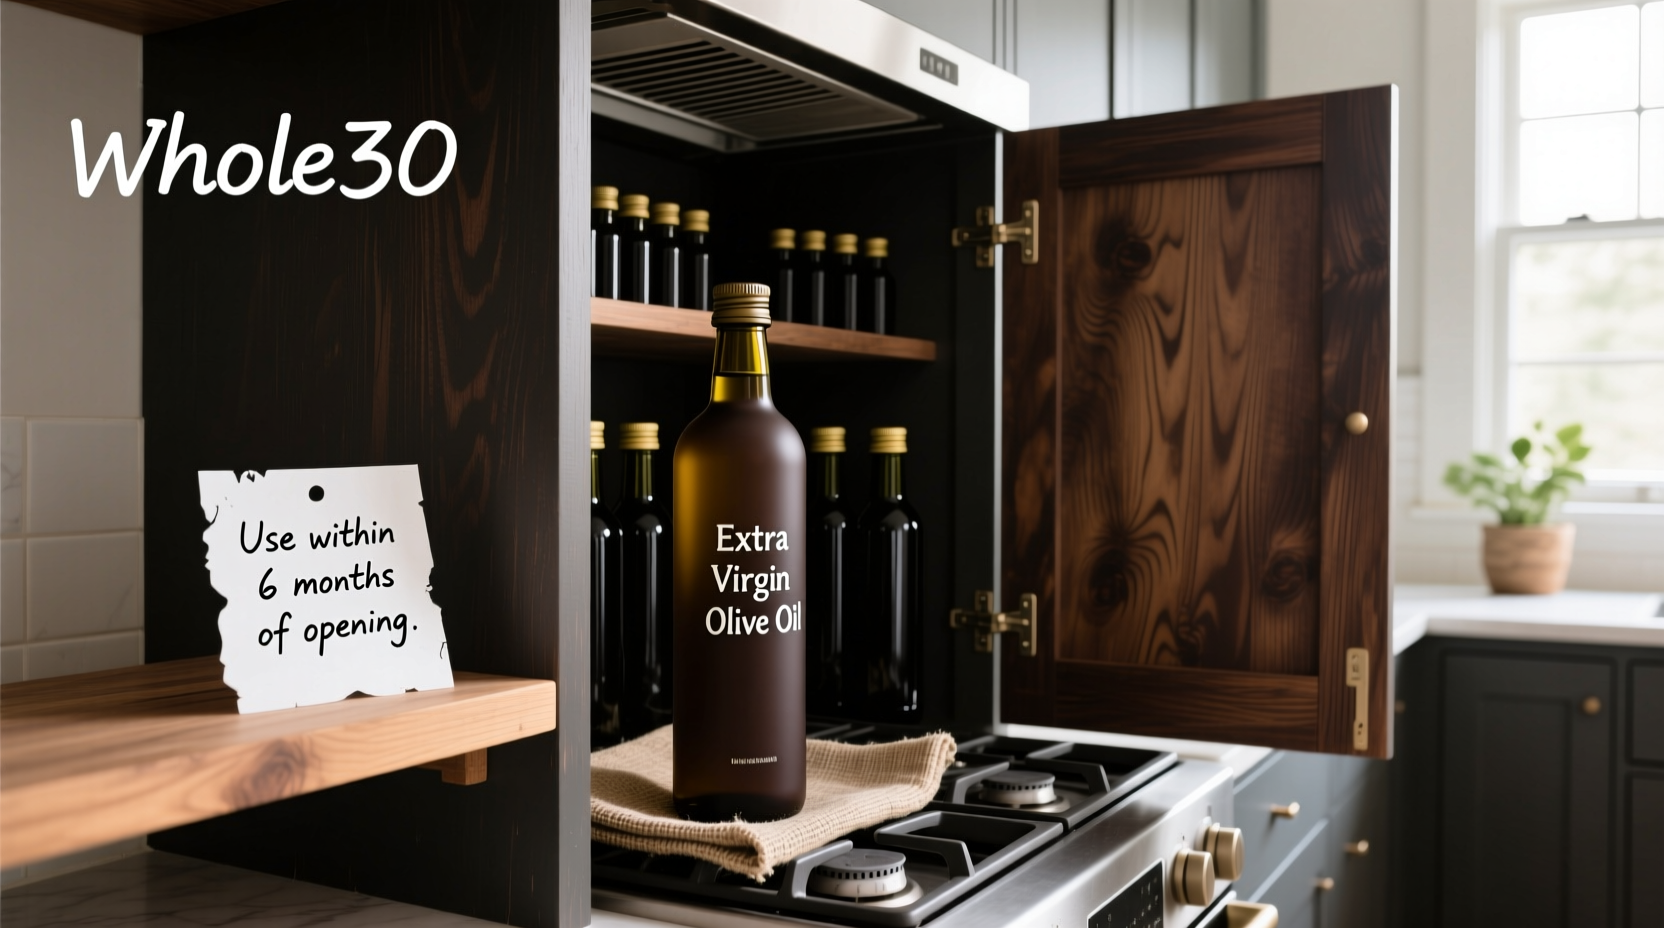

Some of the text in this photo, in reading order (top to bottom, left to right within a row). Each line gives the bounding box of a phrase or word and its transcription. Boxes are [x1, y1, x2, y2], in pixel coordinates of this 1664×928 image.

[240, 515, 395, 555] Use within
[716, 524, 790, 552] Extra
[258, 560, 395, 601] 6 months
[710, 564, 791, 602] Virgin
[257, 610, 419, 657] of opening.
[705, 600, 802, 636] Olive Oil
